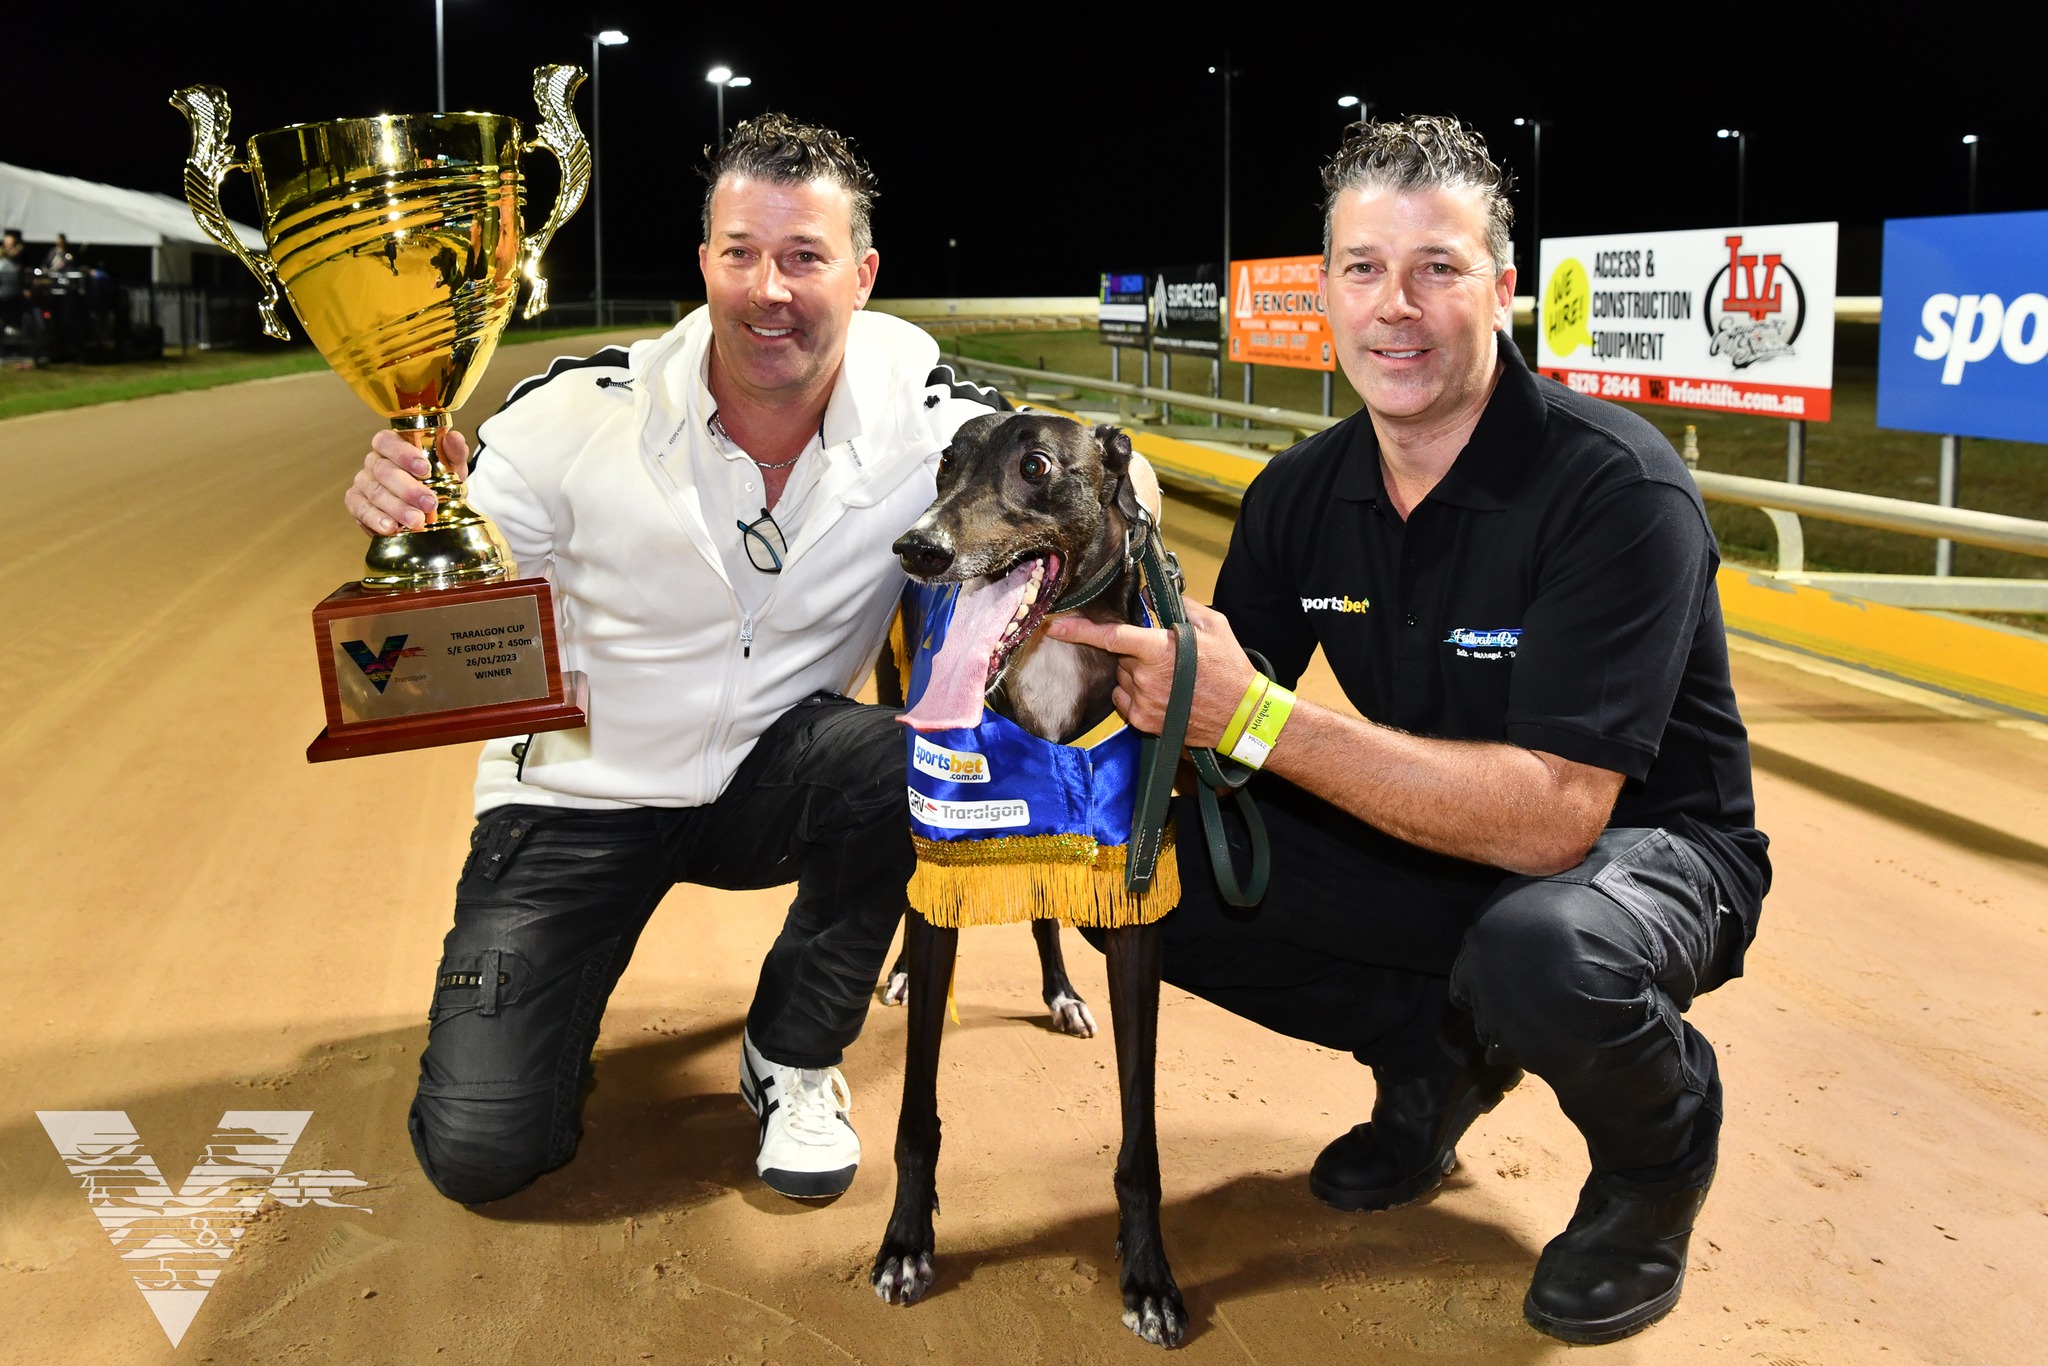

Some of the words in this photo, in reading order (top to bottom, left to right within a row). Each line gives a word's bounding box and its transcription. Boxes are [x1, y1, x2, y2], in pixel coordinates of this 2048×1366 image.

[1593, 250, 1641, 278] ACCESS
[1645, 249, 1655, 278] &
[1553, 268, 1574, 301] WE
[1549, 294, 1583, 336] HIRE!
[1592, 290, 1692, 319] CONSTRUCTION
[1591, 331, 1665, 362] EQUIPMENT
[1567, 372, 1600, 395] 5176
[1601, 375, 1641, 398] 2644
[1668, 380, 1805, 415] lvforklifts.com.au
[1300, 595, 1366, 614] portsbet
[451, 627, 505, 641] TRARALGON
[507, 624, 525, 634] CUP
[447, 645, 462, 656] S/E
[464, 643, 496, 653] GROUP
[498, 641, 503, 649] 2
[508, 638, 532, 648] 450m
[466, 653, 517, 667] 26/01/2023
[394, 674, 427, 684] Traralgon
[475, 668, 512, 680] WINNER
[1251, 700, 1272, 731] Marquee
[915, 745, 983, 773] sportsbet
[941, 804, 1024, 822] Traralgon
